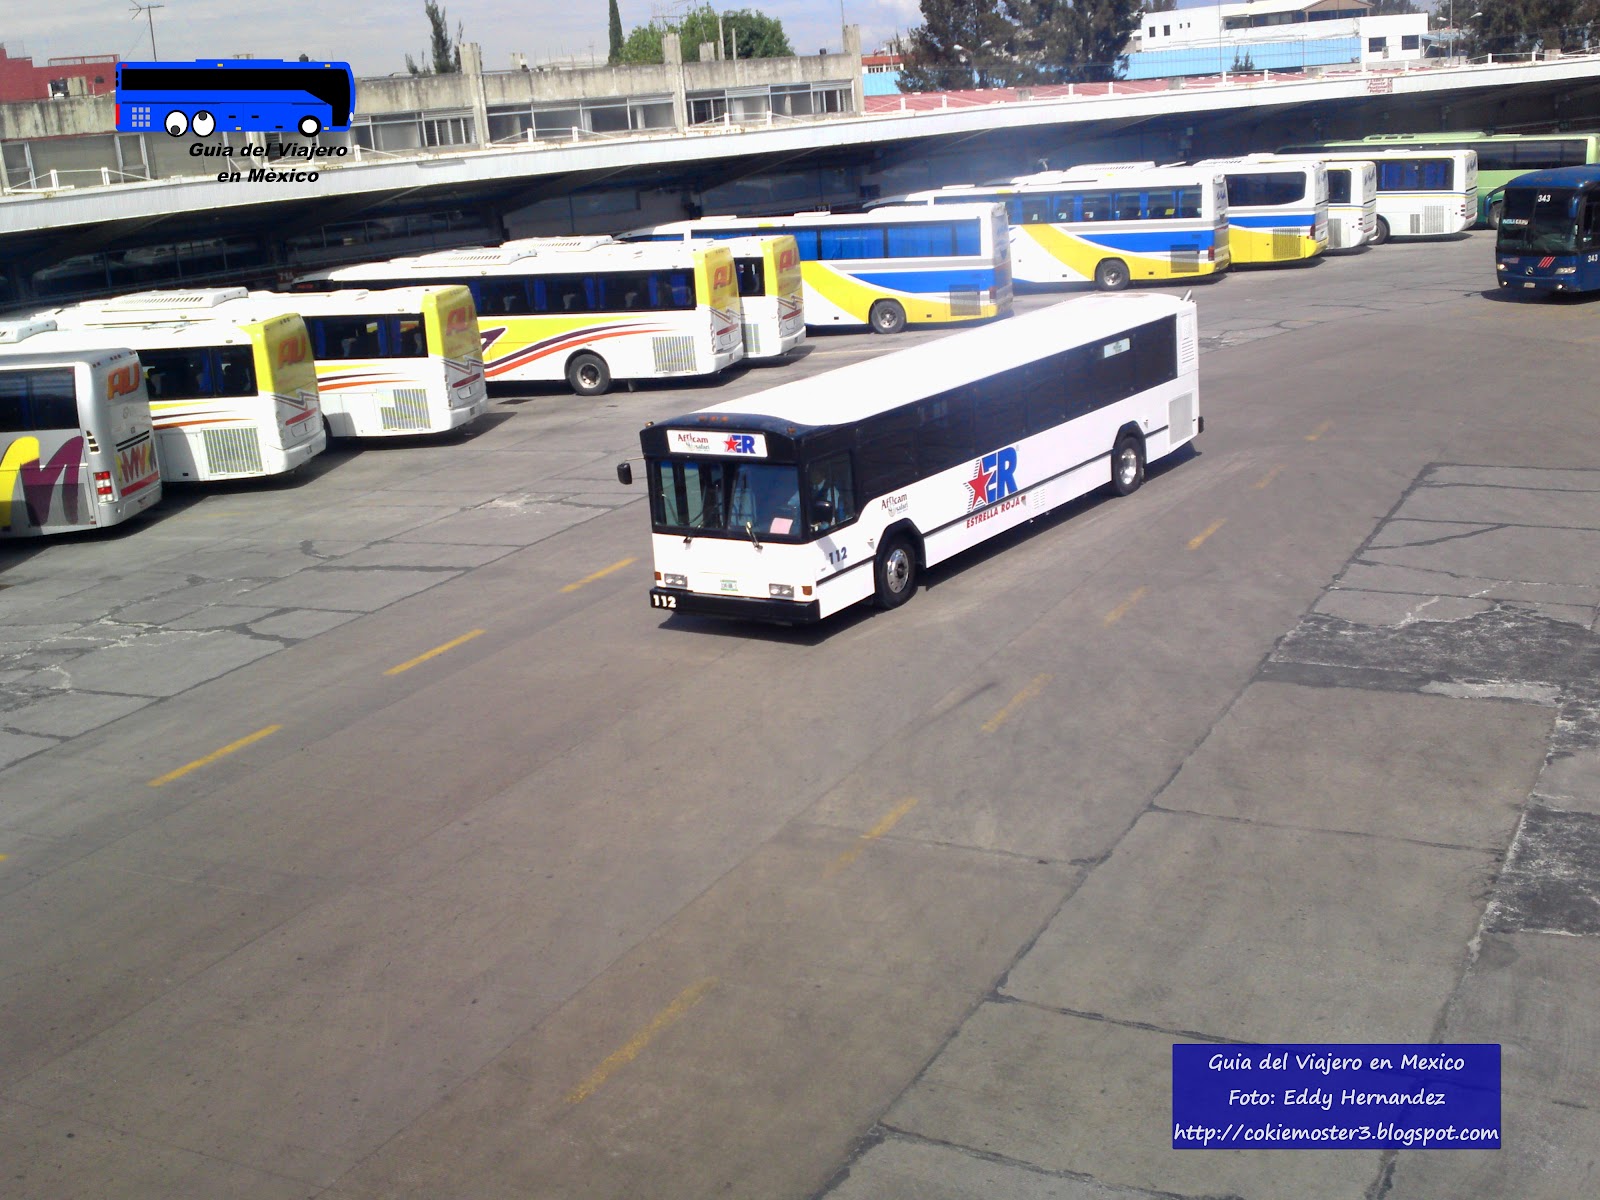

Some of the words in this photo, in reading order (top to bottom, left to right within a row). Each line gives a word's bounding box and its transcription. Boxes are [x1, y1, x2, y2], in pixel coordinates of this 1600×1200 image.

[1537, 194, 1552, 203] 343
[1587, 254, 1599, 263] 343
[107, 362, 140, 400] AU
[966, 510, 999, 529] ESTRELLA
[1001, 497, 1021, 513] ROJA
[828, 547, 848, 565] 112
[652, 594, 677, 608] 112
